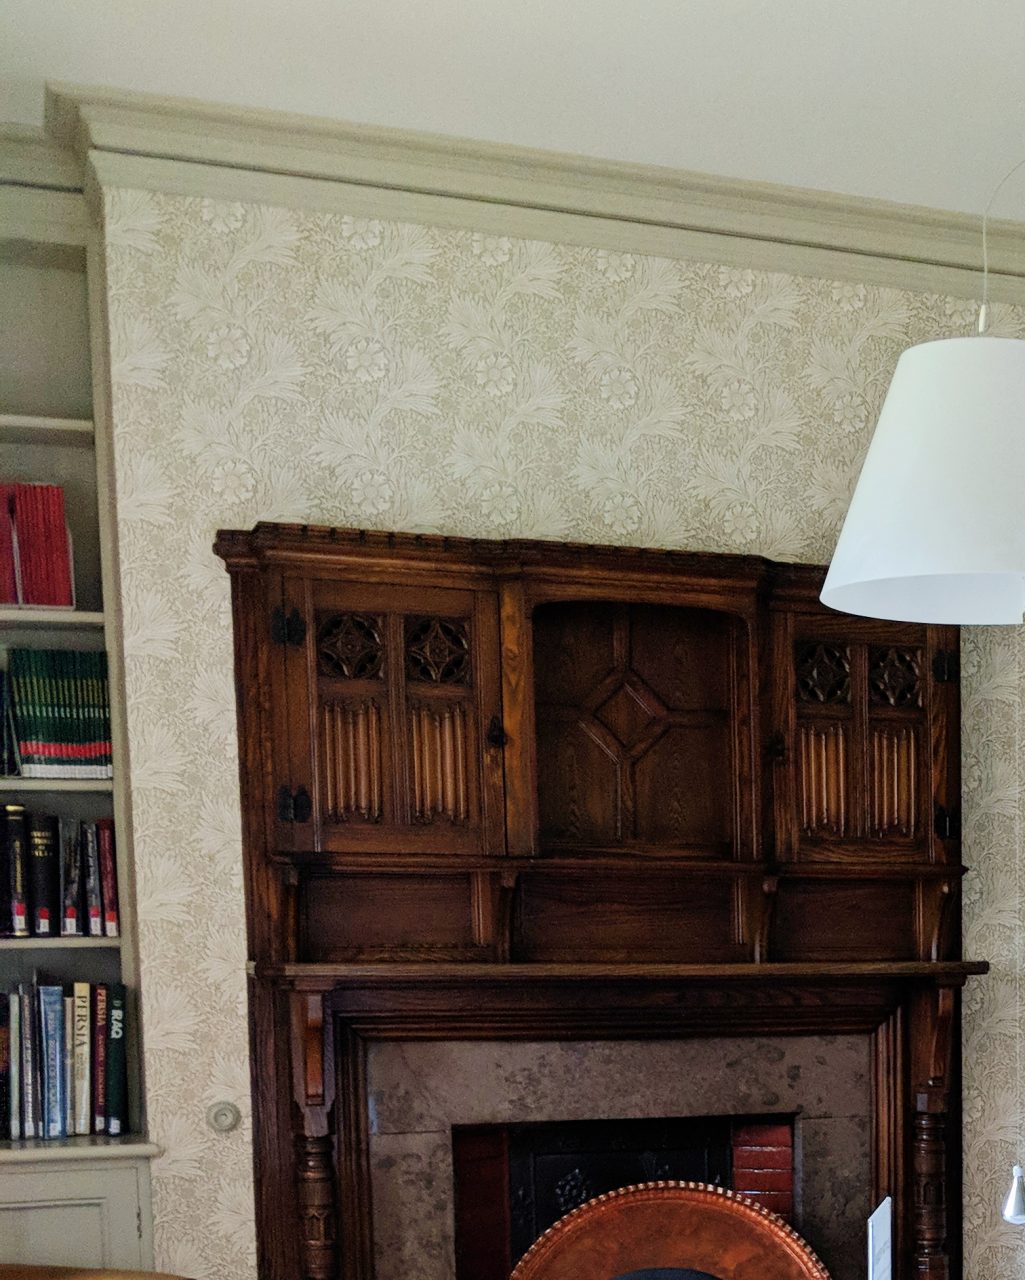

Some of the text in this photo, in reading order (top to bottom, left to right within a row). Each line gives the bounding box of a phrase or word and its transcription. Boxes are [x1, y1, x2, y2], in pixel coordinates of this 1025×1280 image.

[75, 995, 88, 1048] PERSIA
[96, 989, 107, 1026] PERSIA
[110, 1009, 123, 1039] IRAQ
